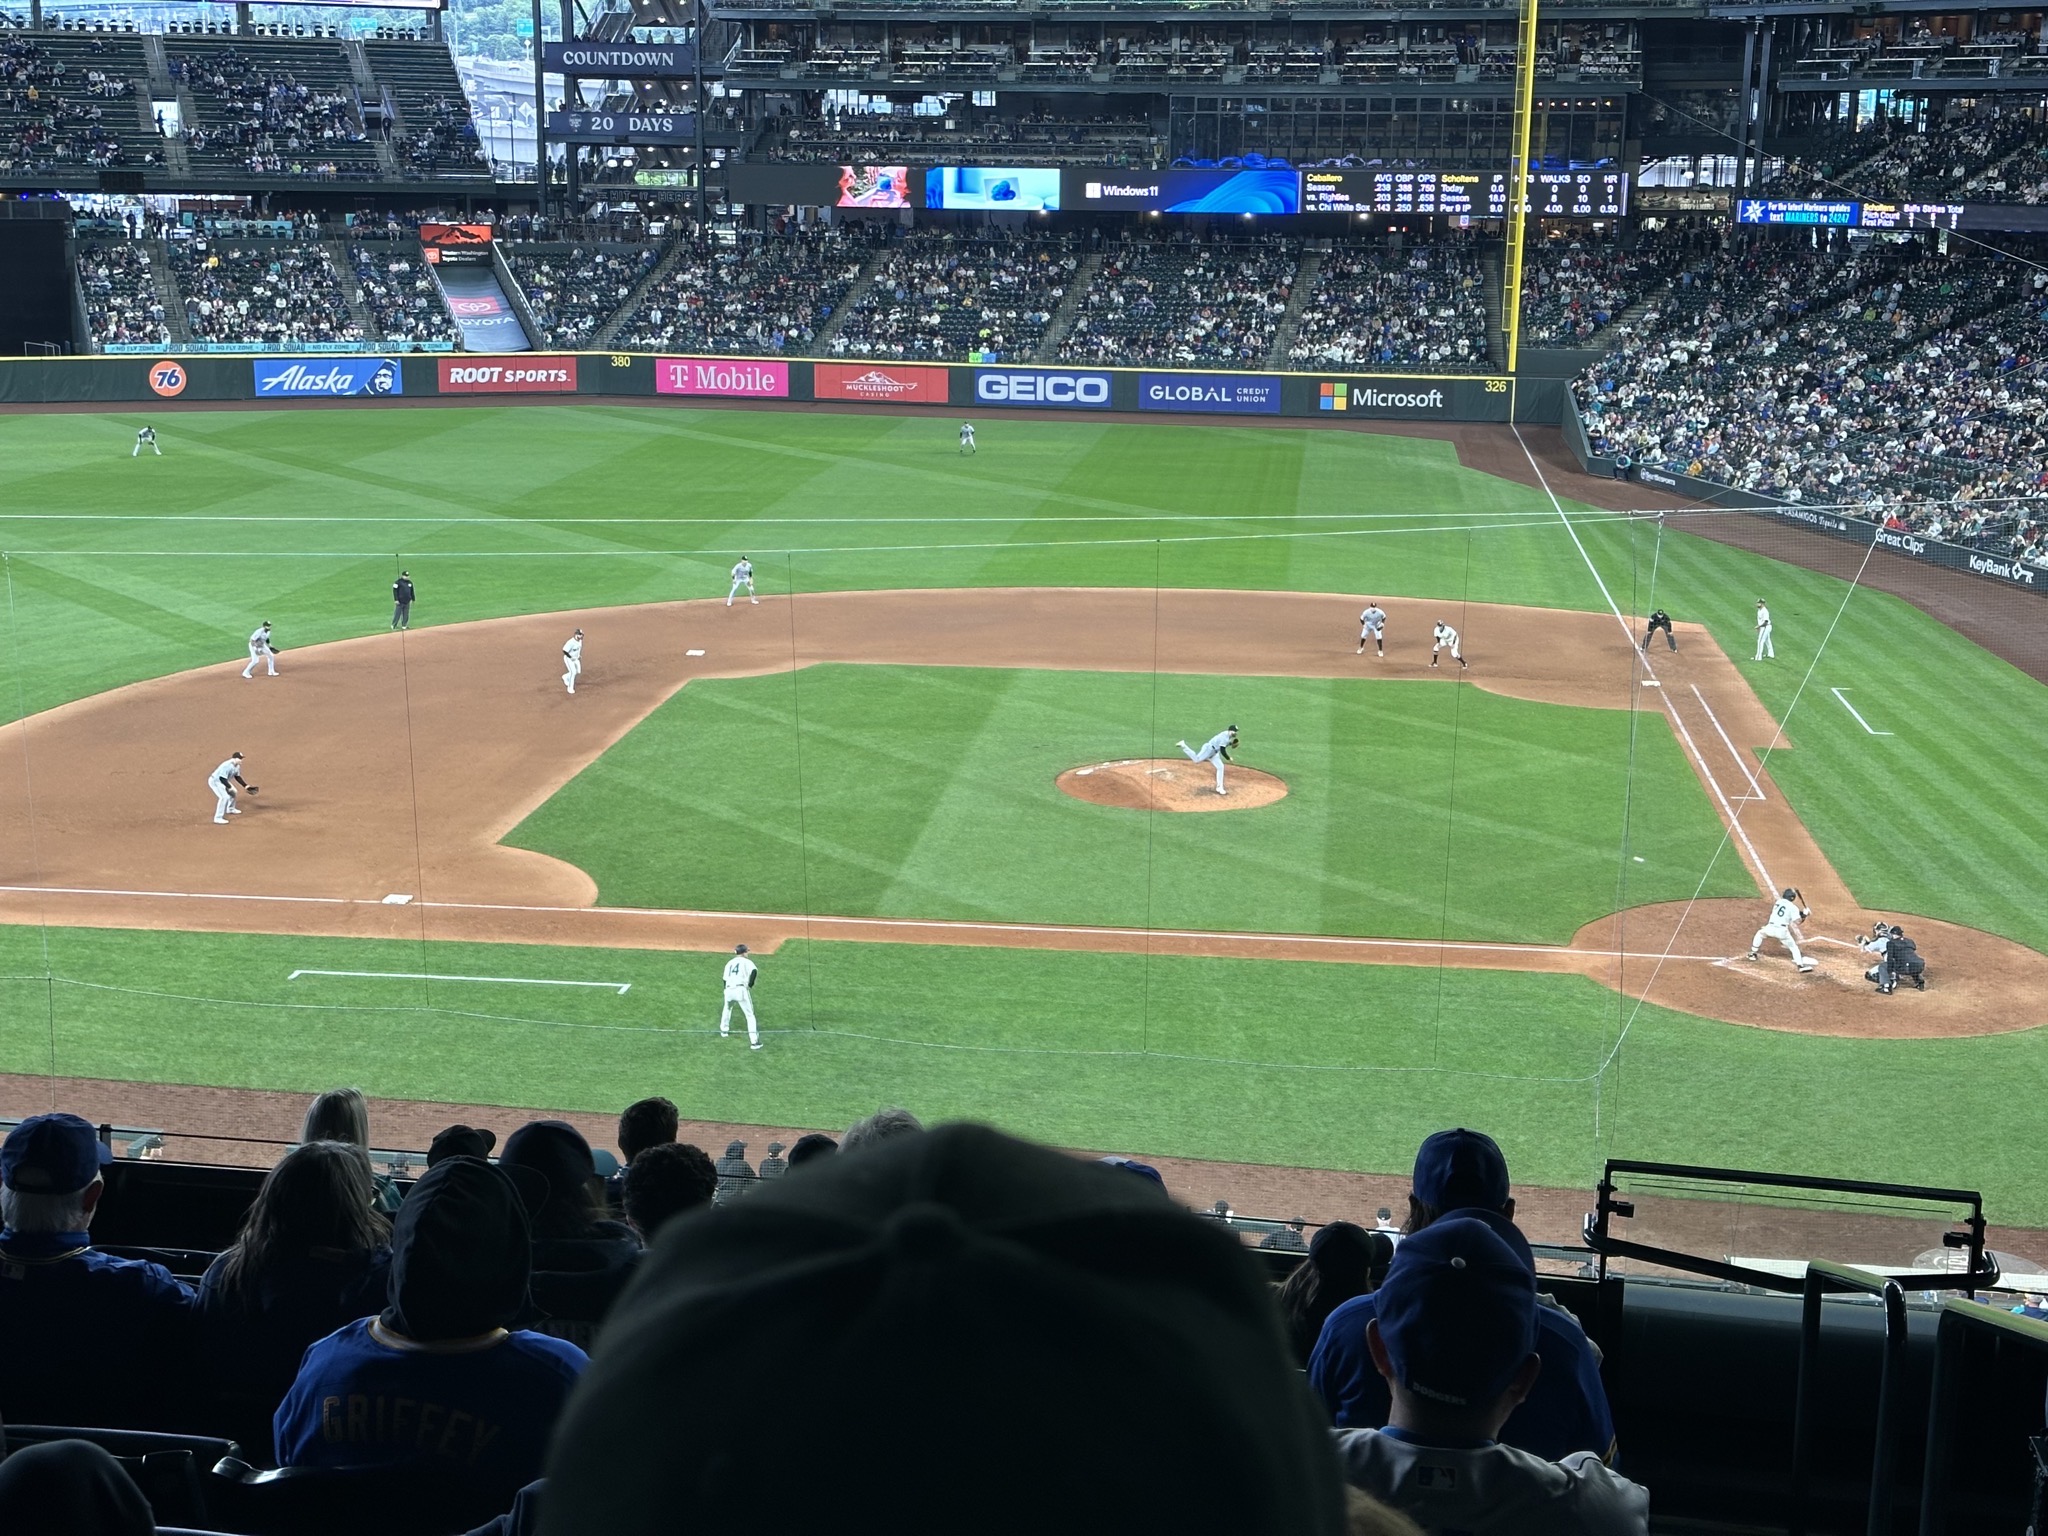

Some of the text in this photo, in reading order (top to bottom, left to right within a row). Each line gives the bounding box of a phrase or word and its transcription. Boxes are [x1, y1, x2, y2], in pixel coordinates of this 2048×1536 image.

[563, 51, 674, 67] COUNTDOWN
[591, 117, 614, 131] 20
[629, 117, 673, 132] DAYS
[1307, 174, 1436, 182] Caballero AVG OBP OPS
[1441, 174, 1479, 183] Scholtens
[1493, 175, 1503, 183] IP
[1540, 175, 1571, 183] WALKS
[1577, 175, 1590, 184] SO
[1604, 175, 1617, 184] HR
[1103, 184, 1158, 196] Windows 11
[1306, 183, 1335, 192] Season
[1441, 184, 1613, 194] Today 0.0 0 0 0
[1319, 193, 1349, 202] Righties
[1440, 194, 1470, 202] Season
[1578, 194, 1588, 203] 10
[1608, 194, 1613, 202] 1
[1318, 203, 1331, 211] Chi
[1333, 203, 1354, 211] White
[1355, 203, 1370, 211] Sox
[1440, 204, 1454, 212] Per
[1462, 204, 1472, 212] IP
[1544, 205, 1563, 213] 4.00
[1572, 205, 1591, 213] 5.00
[1599, 205, 1619, 213] 0.50
[1768, 202, 1850, 214] For the latest Mariners updates
[1904, 204, 1920, 212] Balls
[1922, 205, 1945, 213] Strikes
[1947, 205, 1964, 214] Total
[1770, 212, 1849, 223] text MARINERS to 24247
[1863, 211, 1879, 219] Pitch
[1880, 212, 1900, 220] Count
[1877, 219, 1894, 227] Pitch
[459, 317, 515, 326] OYOTA
[611, 355, 631, 367] 380
[155, 368, 181, 388] 76
[262, 365, 354, 393] Alaska
[450, 367, 567, 383] ROOT SPORTS
[670, 365, 775, 392] T Mobile
[846, 384, 904, 393] MUCKLESHOOT
[978, 374, 1108, 403] GEICO
[1236, 387, 1269, 395] CREDIT
[1485, 380, 1507, 393] 326
[1150, 385, 1232, 402] GLOBAL
[1236, 395, 1266, 403] UNION
[1353, 388, 1443, 408] Microsoft
[1784, 507, 1818, 524] CASAMIGOS
[1875, 527, 1924, 555] Great Clips
[1969, 555, 2011, 578] KeyBank
[728, 962, 740, 977] 14
[1412, 1380, 1468, 1406] DODGERS
[322, 1393, 502, 1467] GRIFFEY
